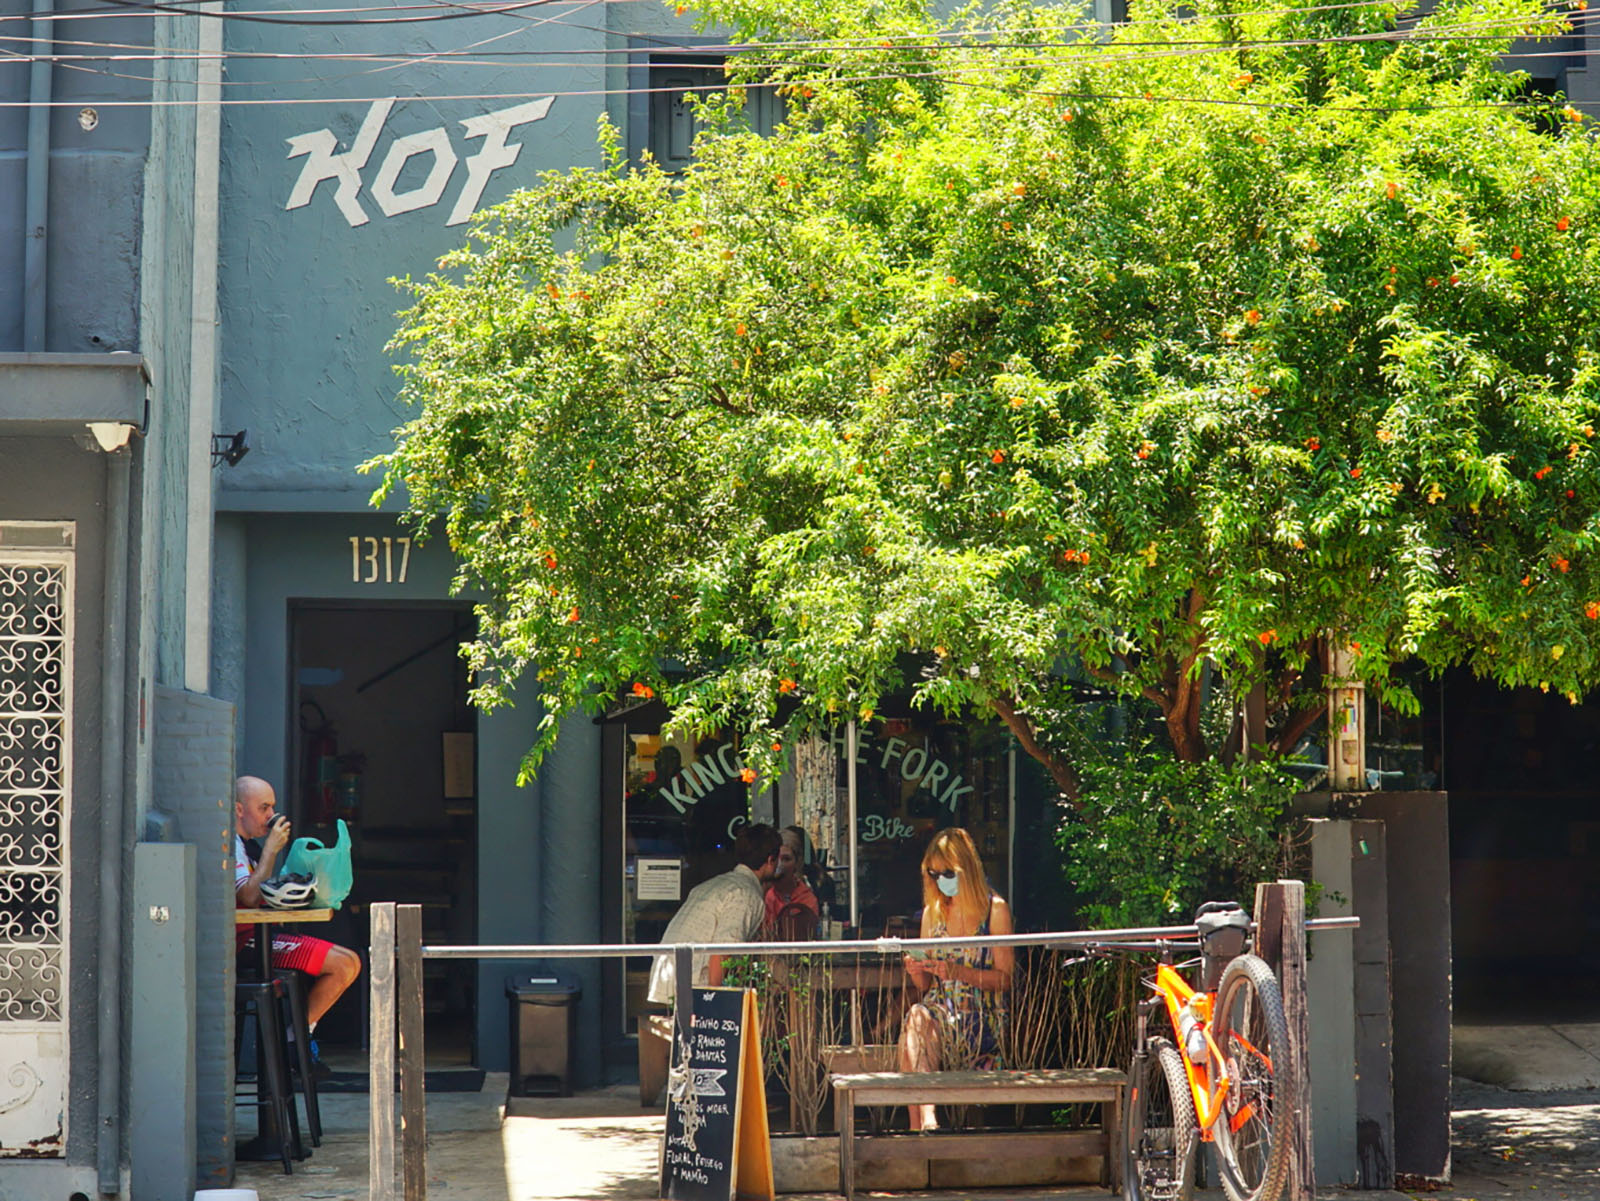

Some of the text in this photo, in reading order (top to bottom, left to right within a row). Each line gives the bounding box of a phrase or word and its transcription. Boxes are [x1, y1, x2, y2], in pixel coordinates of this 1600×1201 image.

[285, 96, 556, 227] KOF
[349, 536, 411, 583] 1317
[830, 725, 873, 764] HE
[880, 737, 975, 813] FORK
[861, 814, 915, 842] Bike
[695, 1049, 727, 1063] DANTAS
[697, 1034, 726, 1049] RANCHO
